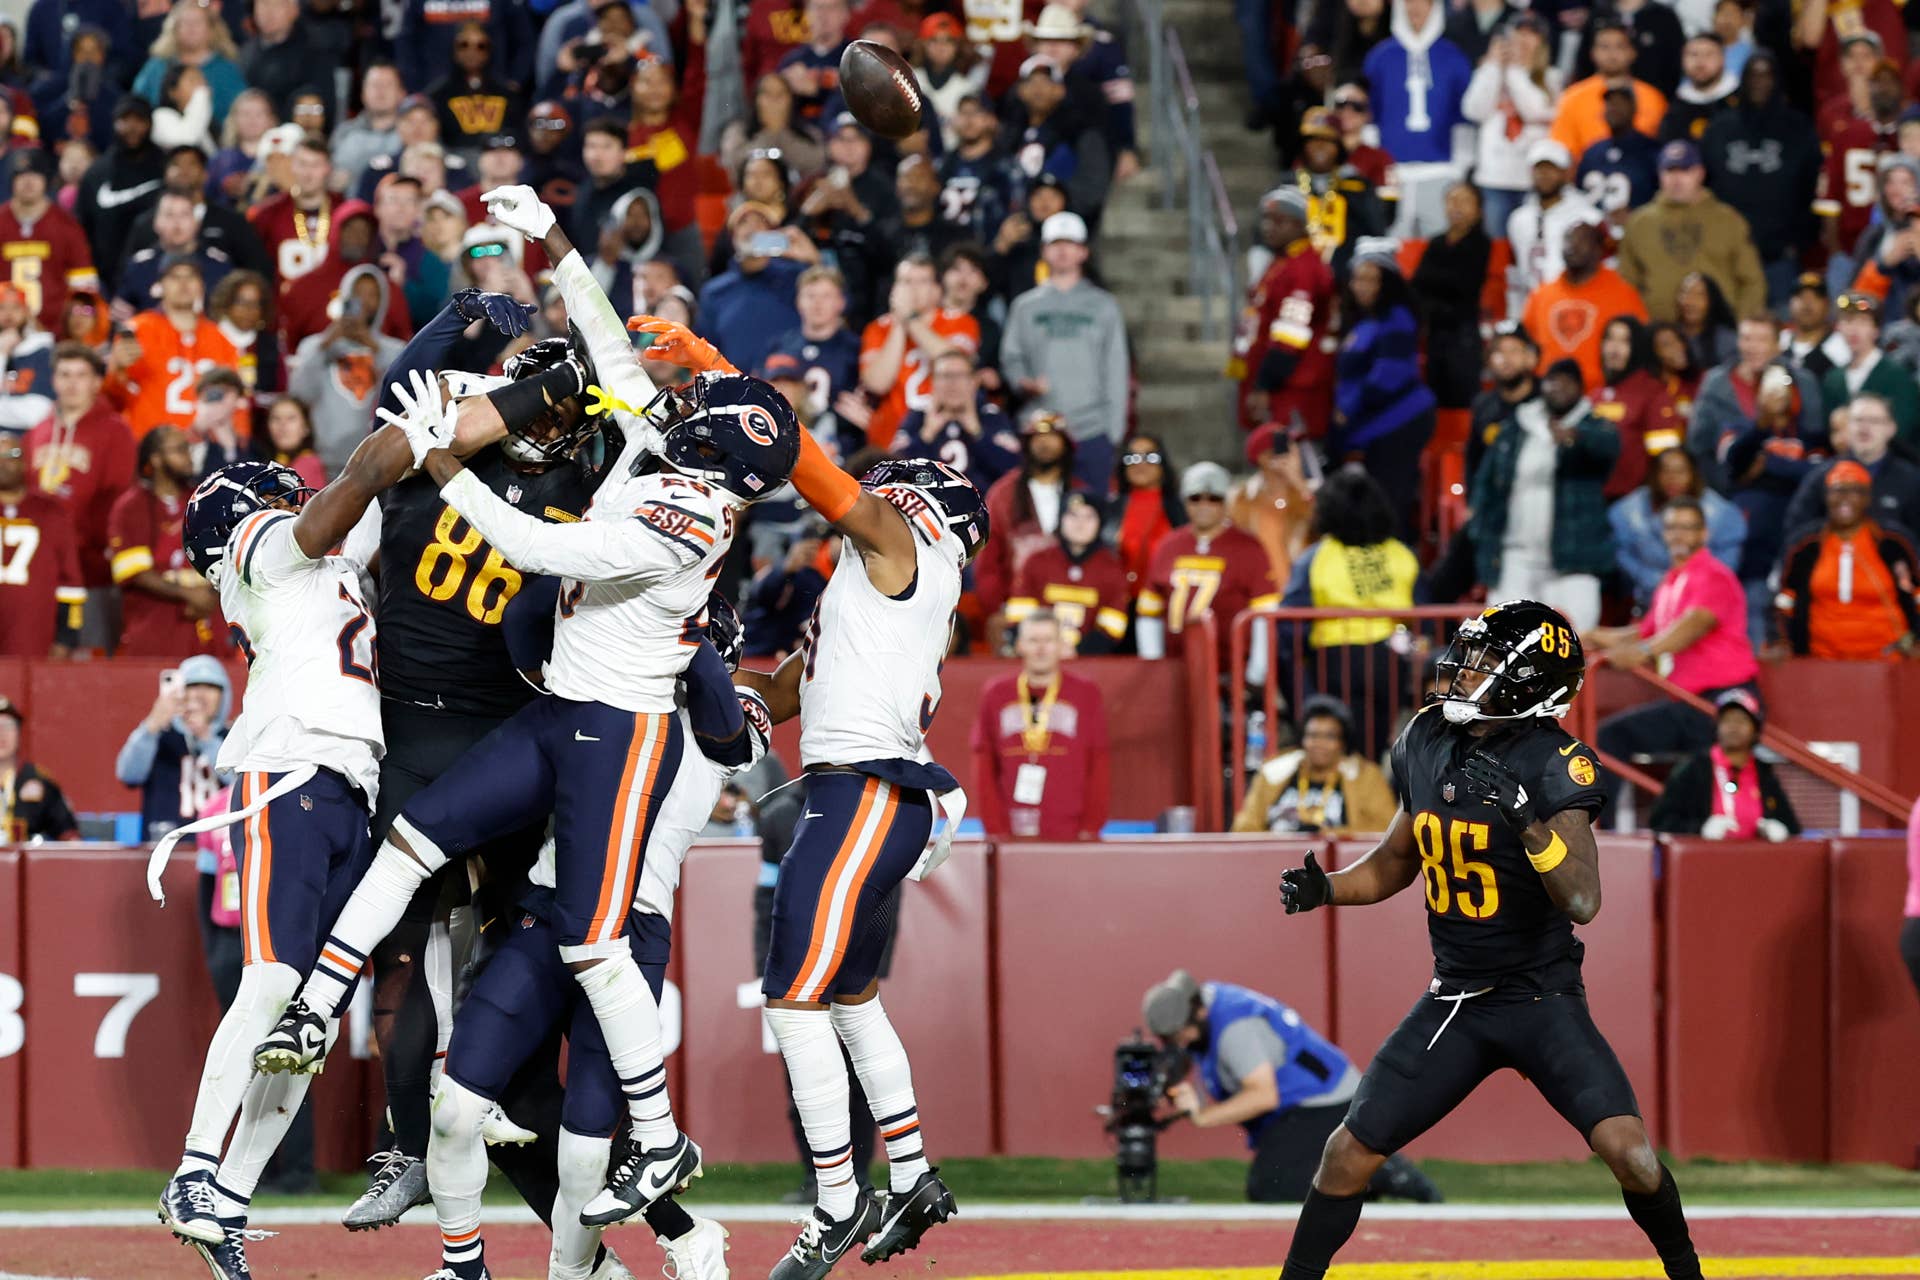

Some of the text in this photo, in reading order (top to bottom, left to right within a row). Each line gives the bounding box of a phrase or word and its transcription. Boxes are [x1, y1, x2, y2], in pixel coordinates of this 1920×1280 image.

[165, 356, 216, 415] 2
[647, 505, 695, 538] GSH
[884, 486, 929, 520] GSH
[415, 502, 524, 625] 86
[1169, 568, 1222, 633] 17
[1541, 621, 1571, 659] 85
[1412, 810, 1500, 920] 85
